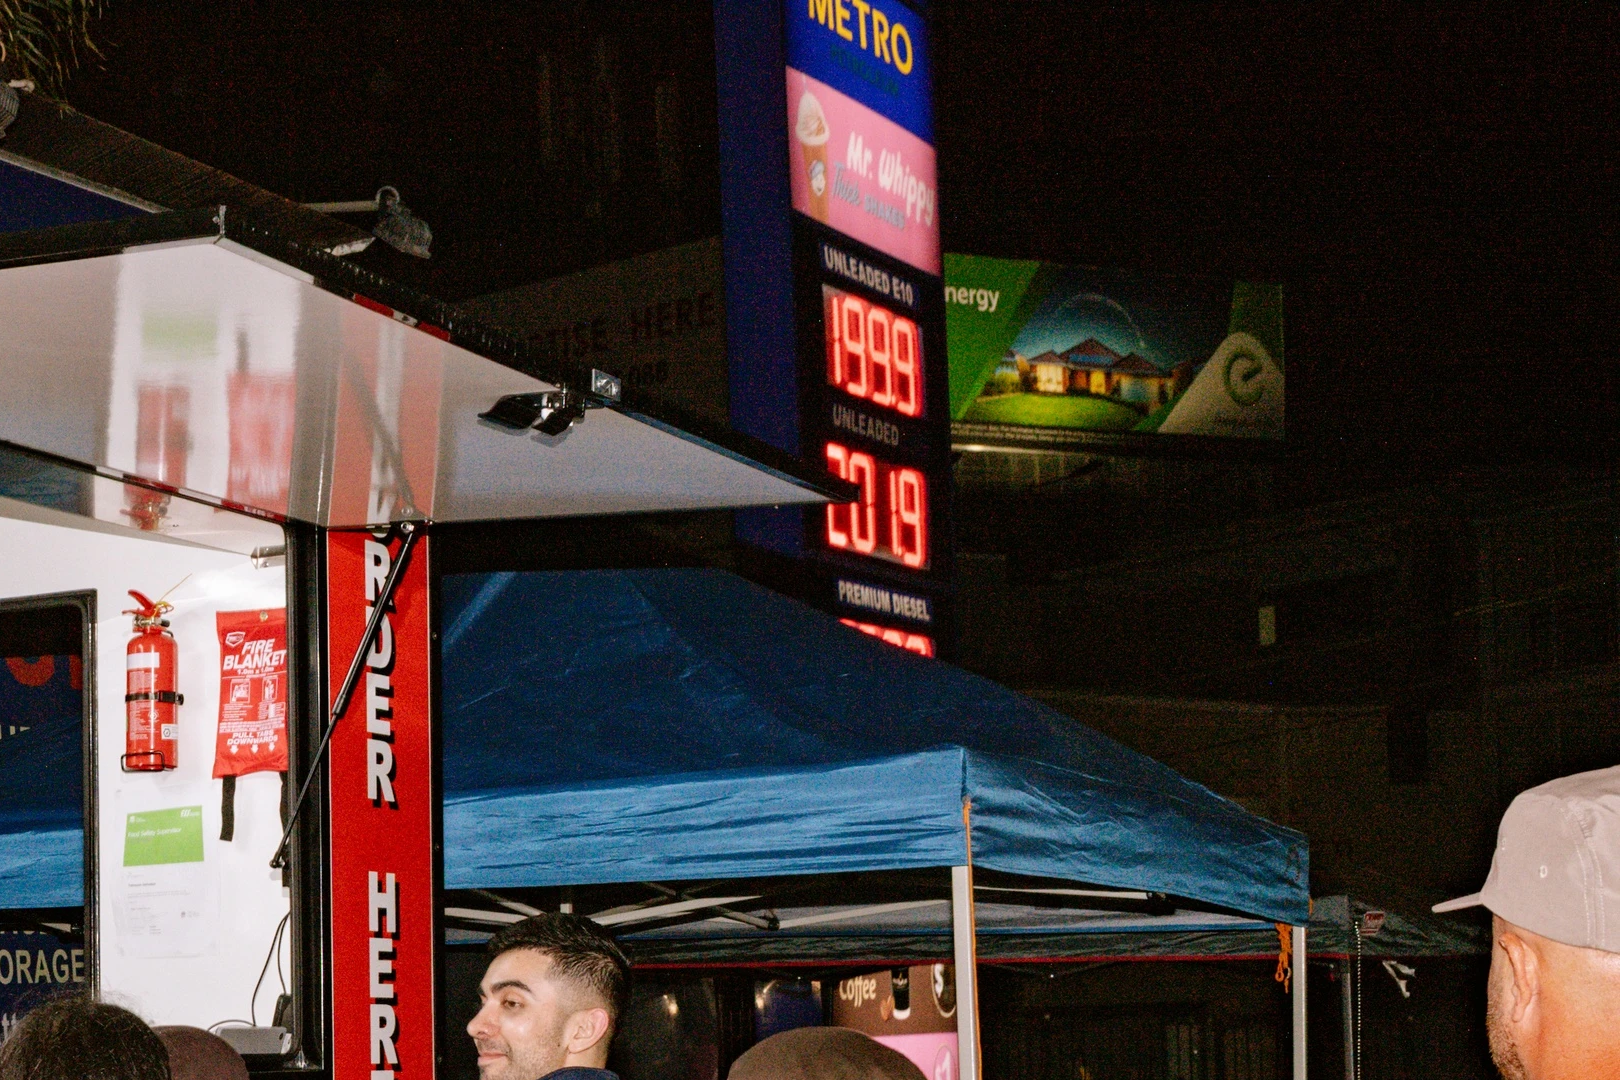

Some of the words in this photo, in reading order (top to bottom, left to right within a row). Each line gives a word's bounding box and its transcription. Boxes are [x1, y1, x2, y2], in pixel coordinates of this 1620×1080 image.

[808, 0, 913, 75] METRO
[847, 131, 873, 180] Mr.
[878, 148, 934, 227] Whippy
[824, 245, 890, 295] UNLEADED
[892, 276, 913, 306] E10
[833, 404, 899, 446] UNLEADED
[838, 580, 891, 613] PREMIUM
[892, 593, 931, 621] DIESEL
[223, 650, 287, 670] BLANKET
[242, 639, 275, 655] FIRE
[363, 533, 397, 803] RDER
[227, 735, 278, 745] DOWNWARDS
